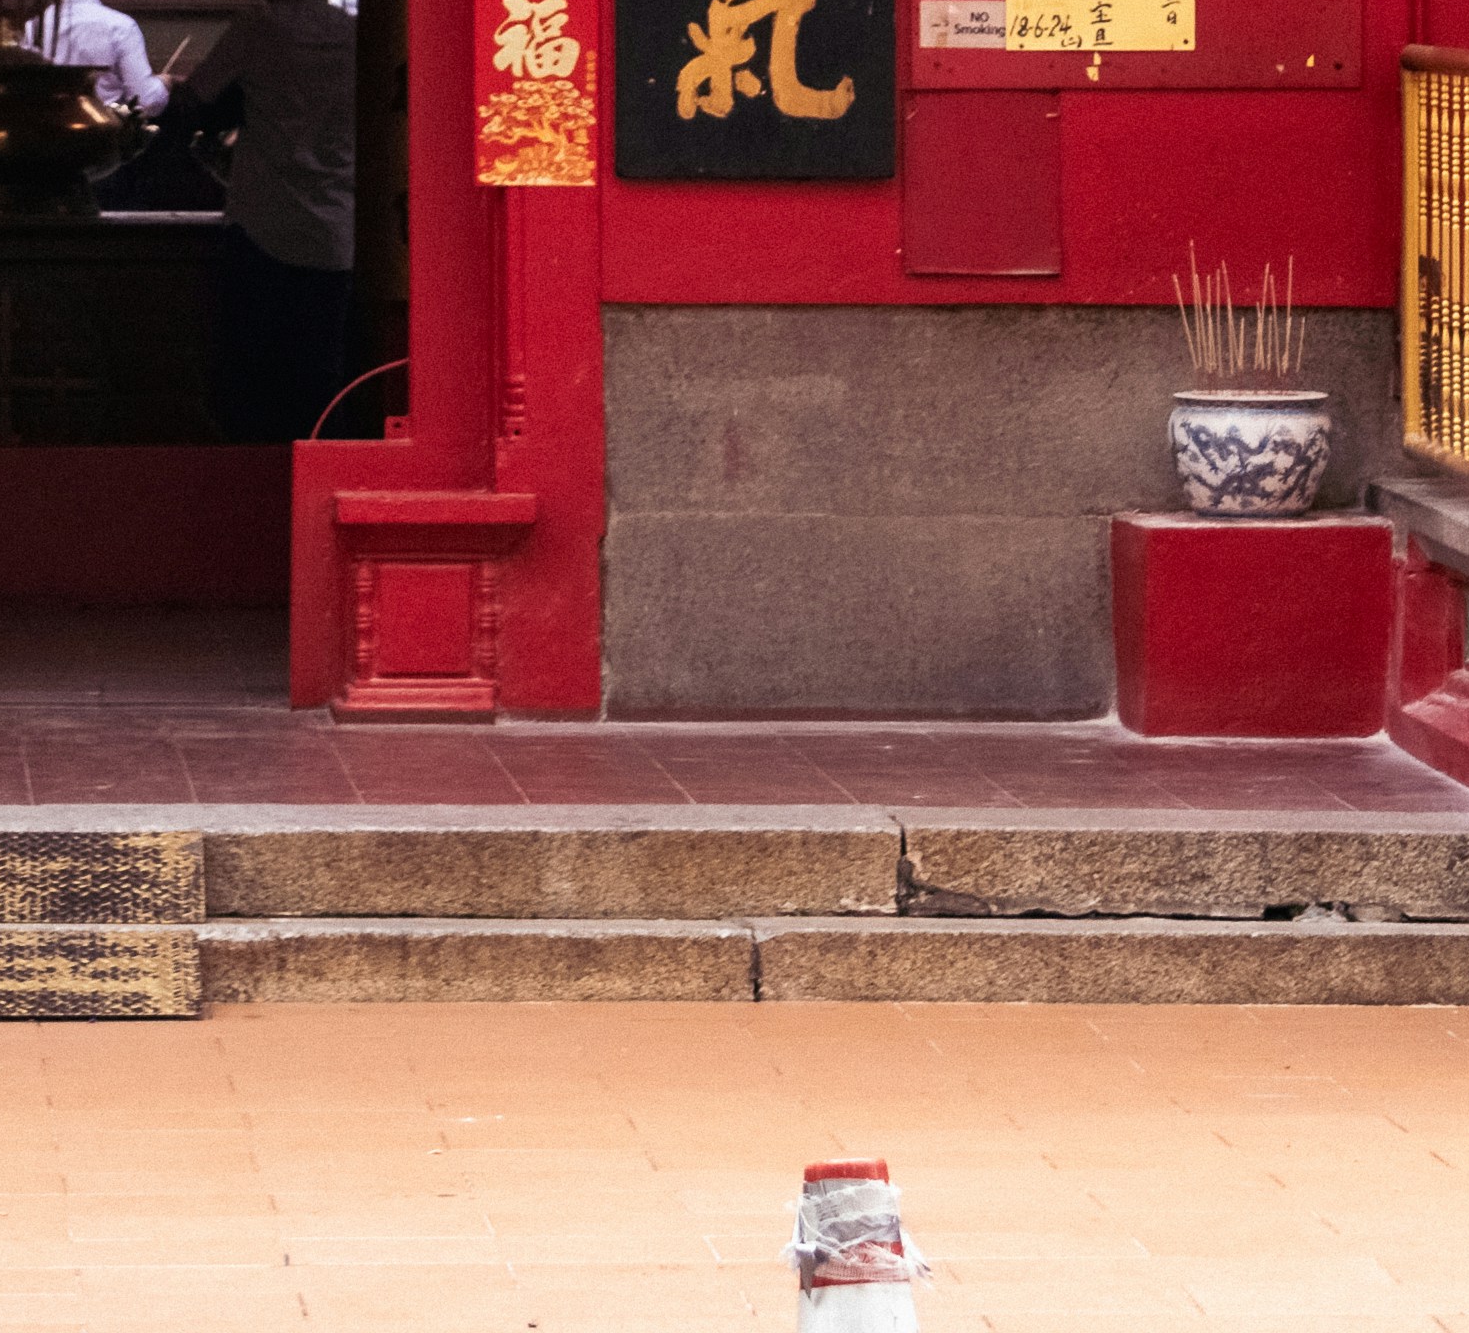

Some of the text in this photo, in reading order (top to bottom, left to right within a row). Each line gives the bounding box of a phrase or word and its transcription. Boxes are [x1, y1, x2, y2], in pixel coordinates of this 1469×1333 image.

[970, 12, 990, 22] NO
[954, 24, 1006, 38] Smoking
[1009, 14, 1073, 38] 18-6-24
